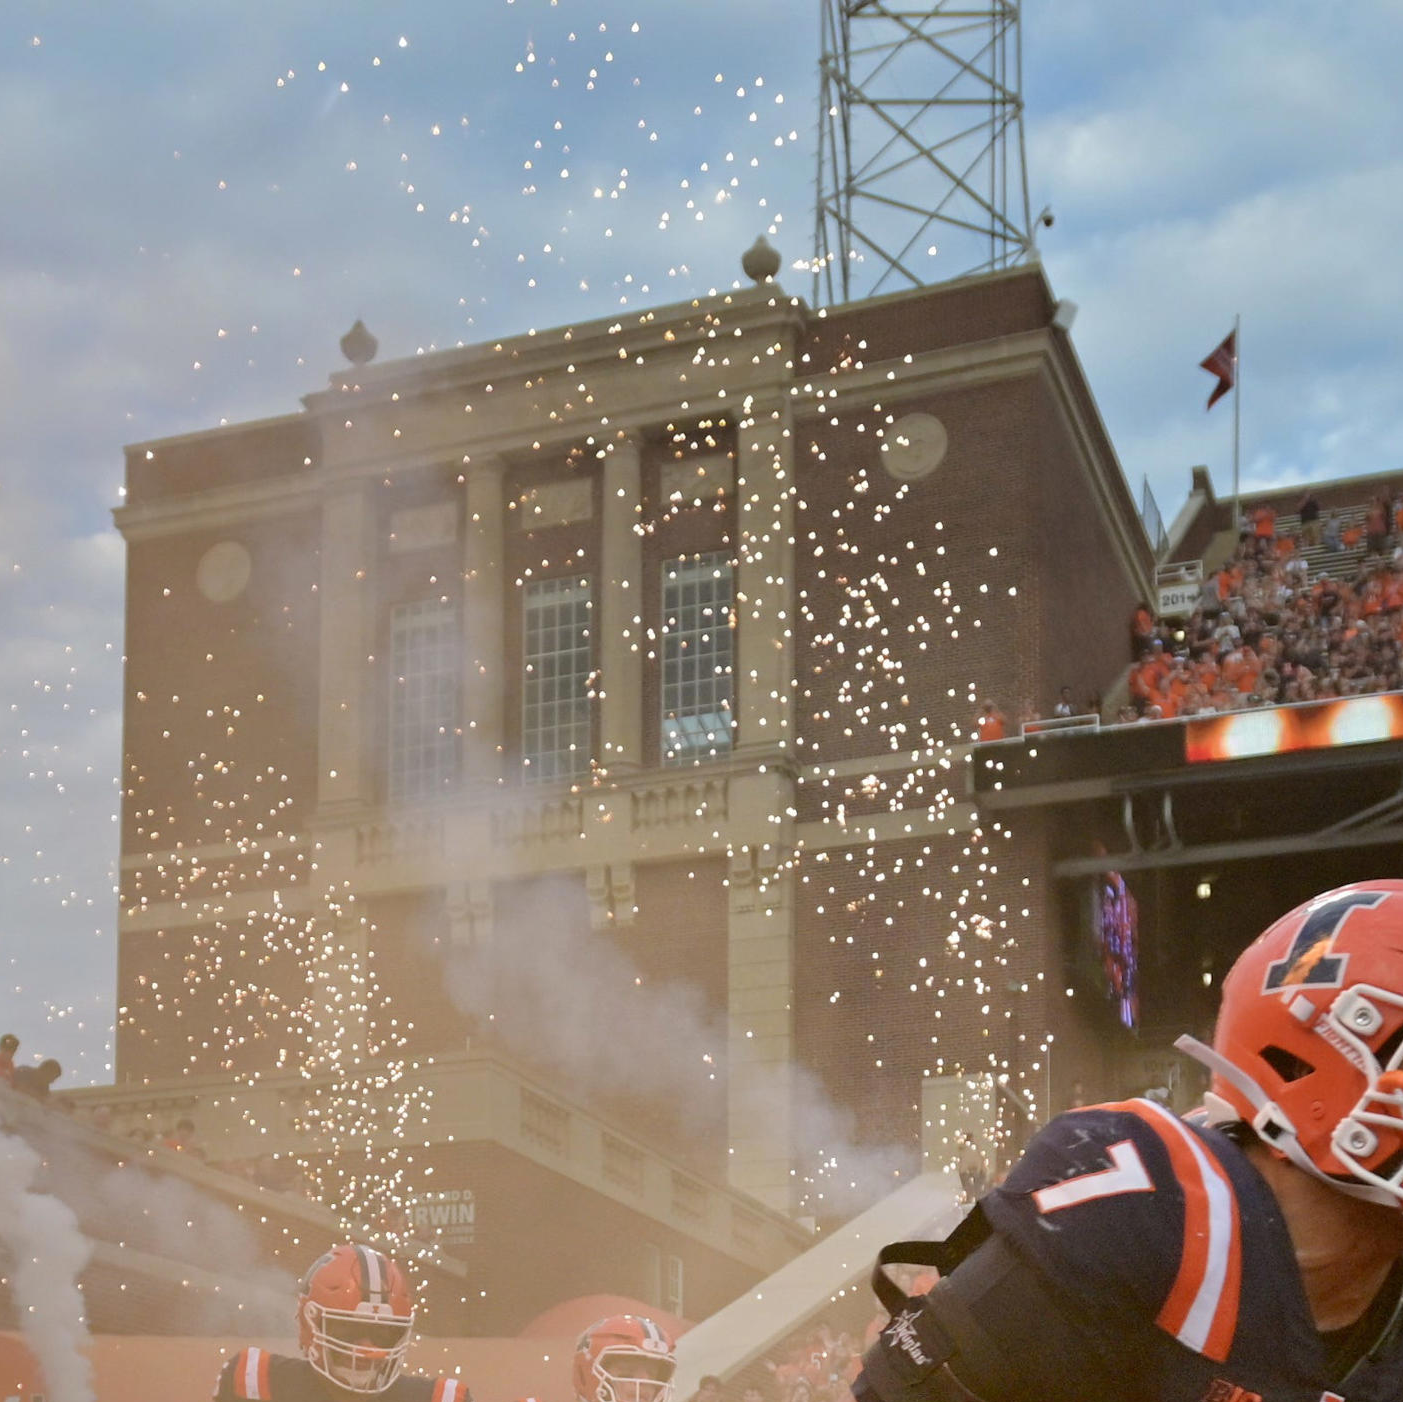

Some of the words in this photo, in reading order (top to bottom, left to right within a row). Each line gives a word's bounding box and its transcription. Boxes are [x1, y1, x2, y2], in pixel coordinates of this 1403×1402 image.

[1162, 594, 1186, 607] 201
[1263, 890, 1392, 997] I
[1031, 1138, 1156, 1215] 7
